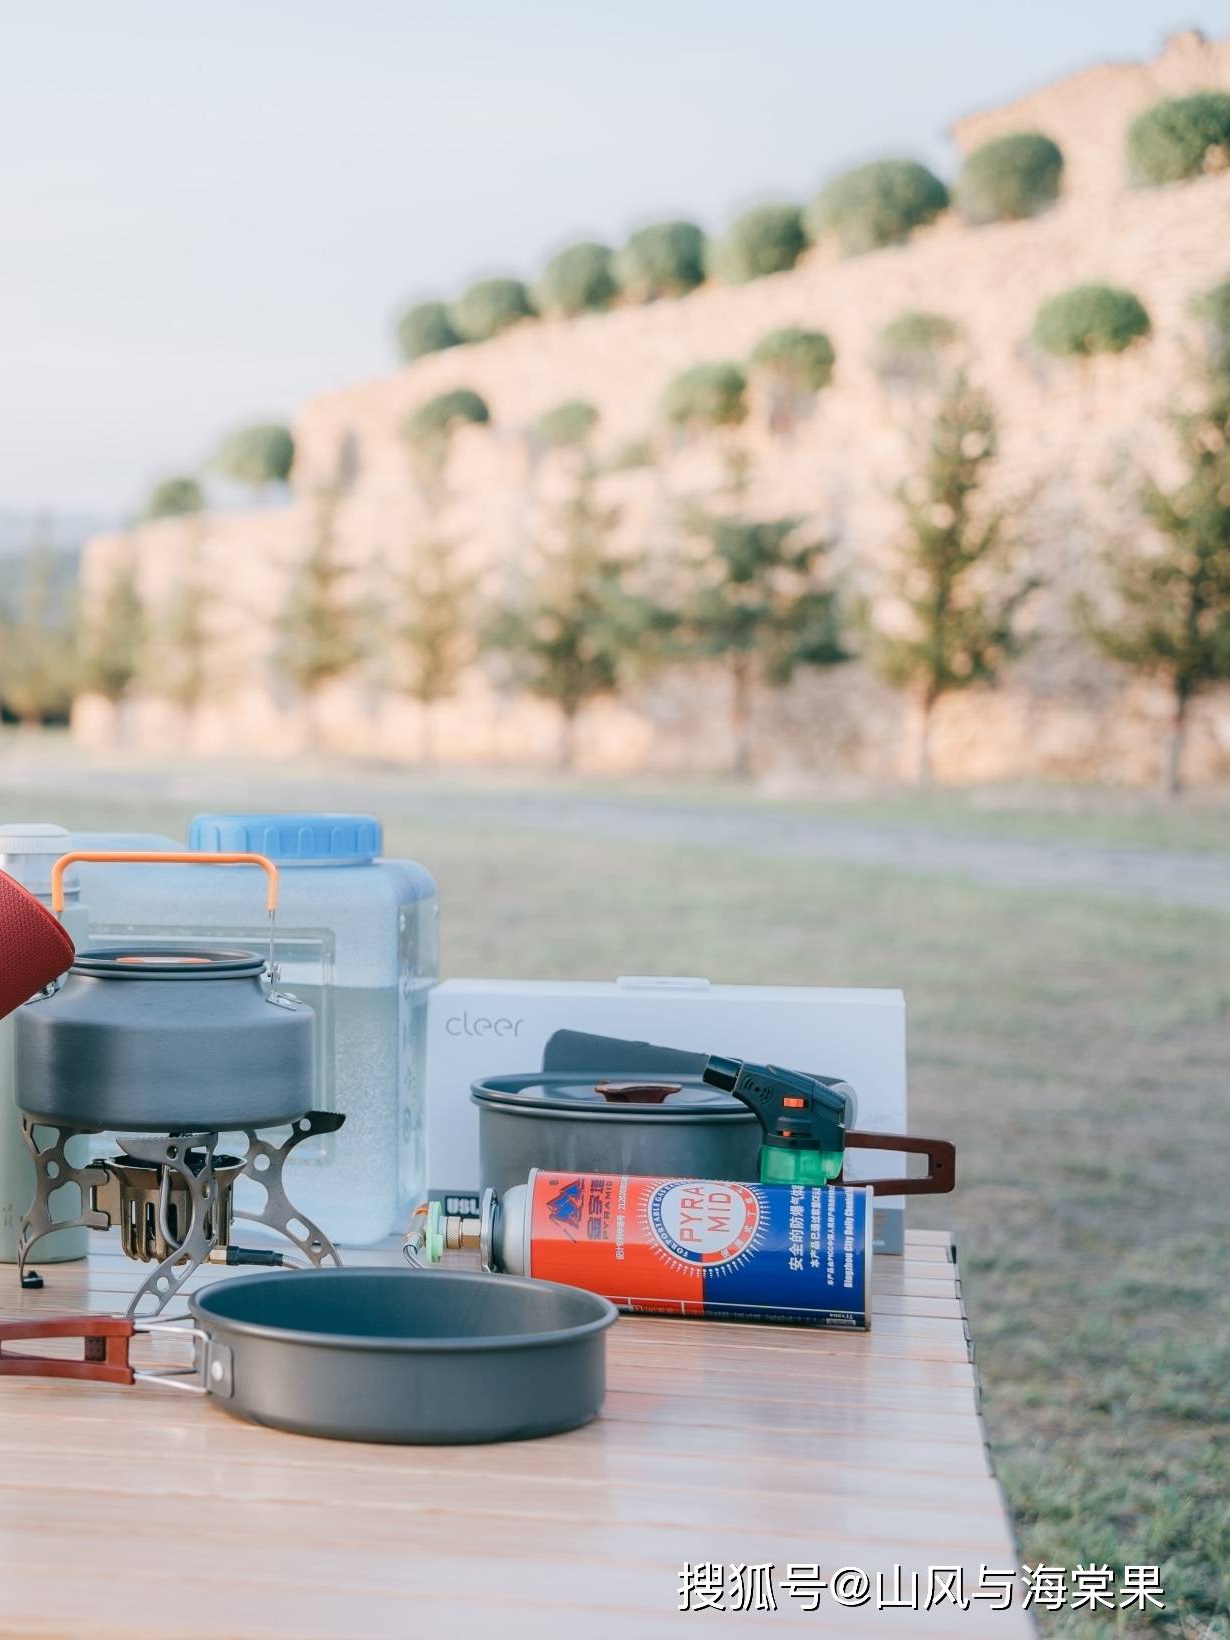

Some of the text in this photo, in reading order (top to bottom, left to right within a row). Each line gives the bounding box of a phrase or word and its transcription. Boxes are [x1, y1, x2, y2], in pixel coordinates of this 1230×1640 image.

[445, 1010, 525, 1037] cleer
[603, 1180, 612, 1240] PYRAMID
[679, 1186, 705, 1242] PYRA
[707, 1193, 732, 1233] MID
[843, 1235, 854, 1252] City
[843, 1253, 855, 1288] Dingzhou
